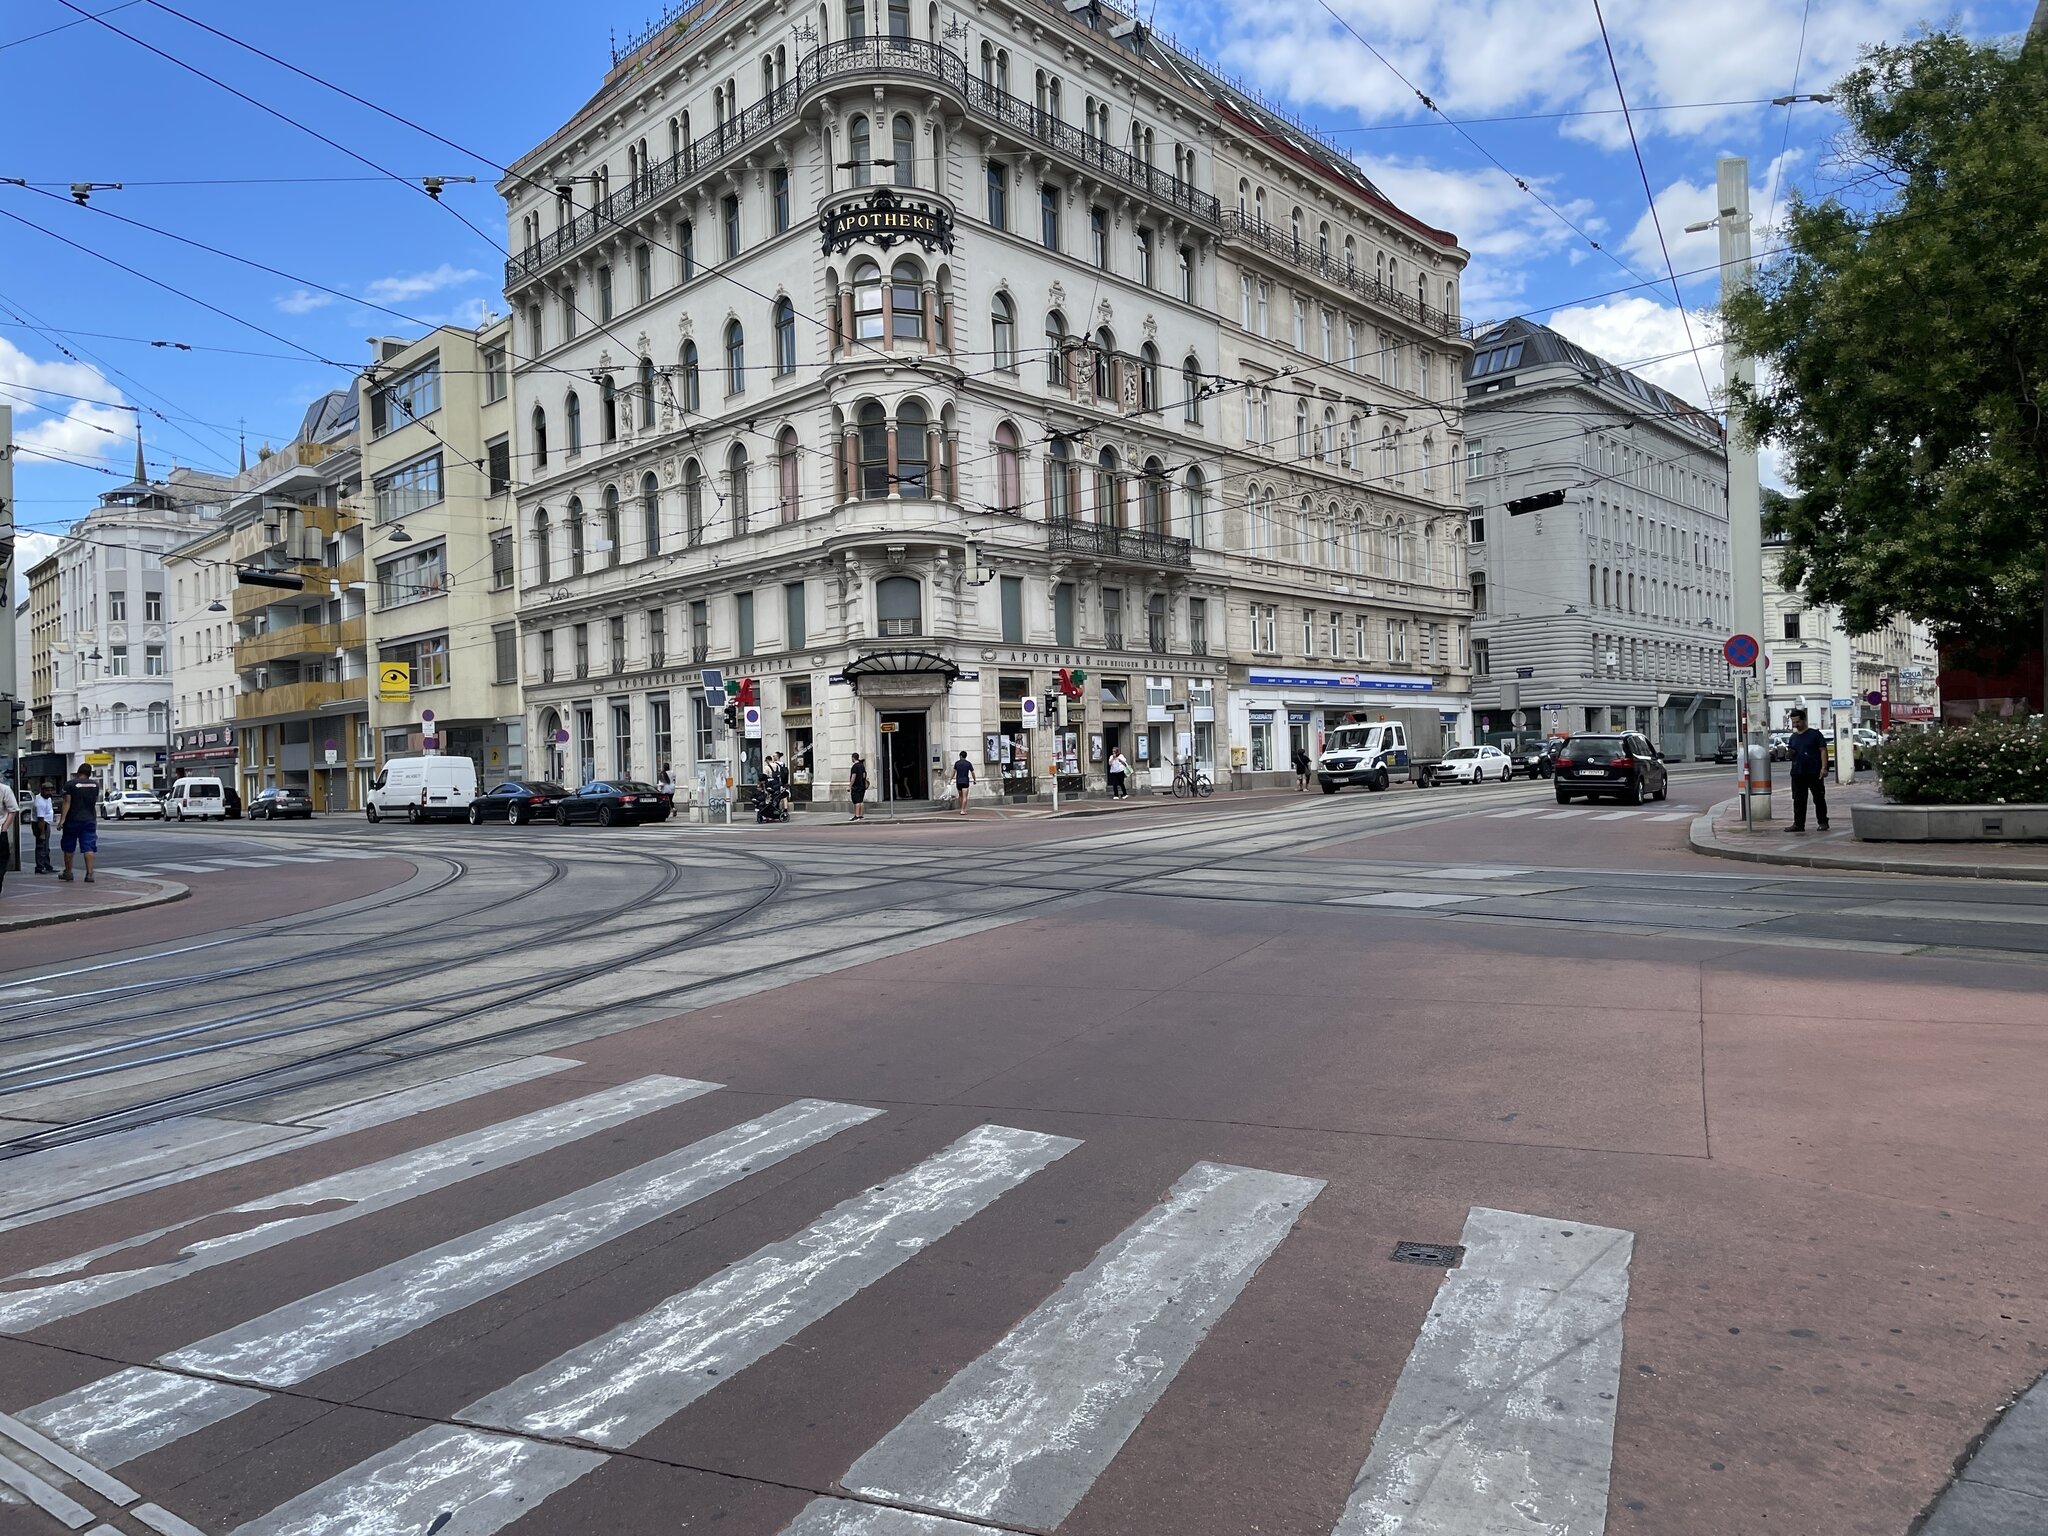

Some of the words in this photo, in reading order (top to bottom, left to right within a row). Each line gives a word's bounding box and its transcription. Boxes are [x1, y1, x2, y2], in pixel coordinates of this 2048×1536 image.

[837, 213, 935, 233] APOTHEKE
[1011, 652, 1091, 666] APOTHEKE
[1144, 659, 1205, 672] BRIGITTA
[618, 673, 676, 690] APOTHEKE
[725, 659, 793, 677] BRIGITTA
[1899, 671, 1922, 679] NOKIA
[1249, 712, 1273, 720] ÖRGERÄTE
